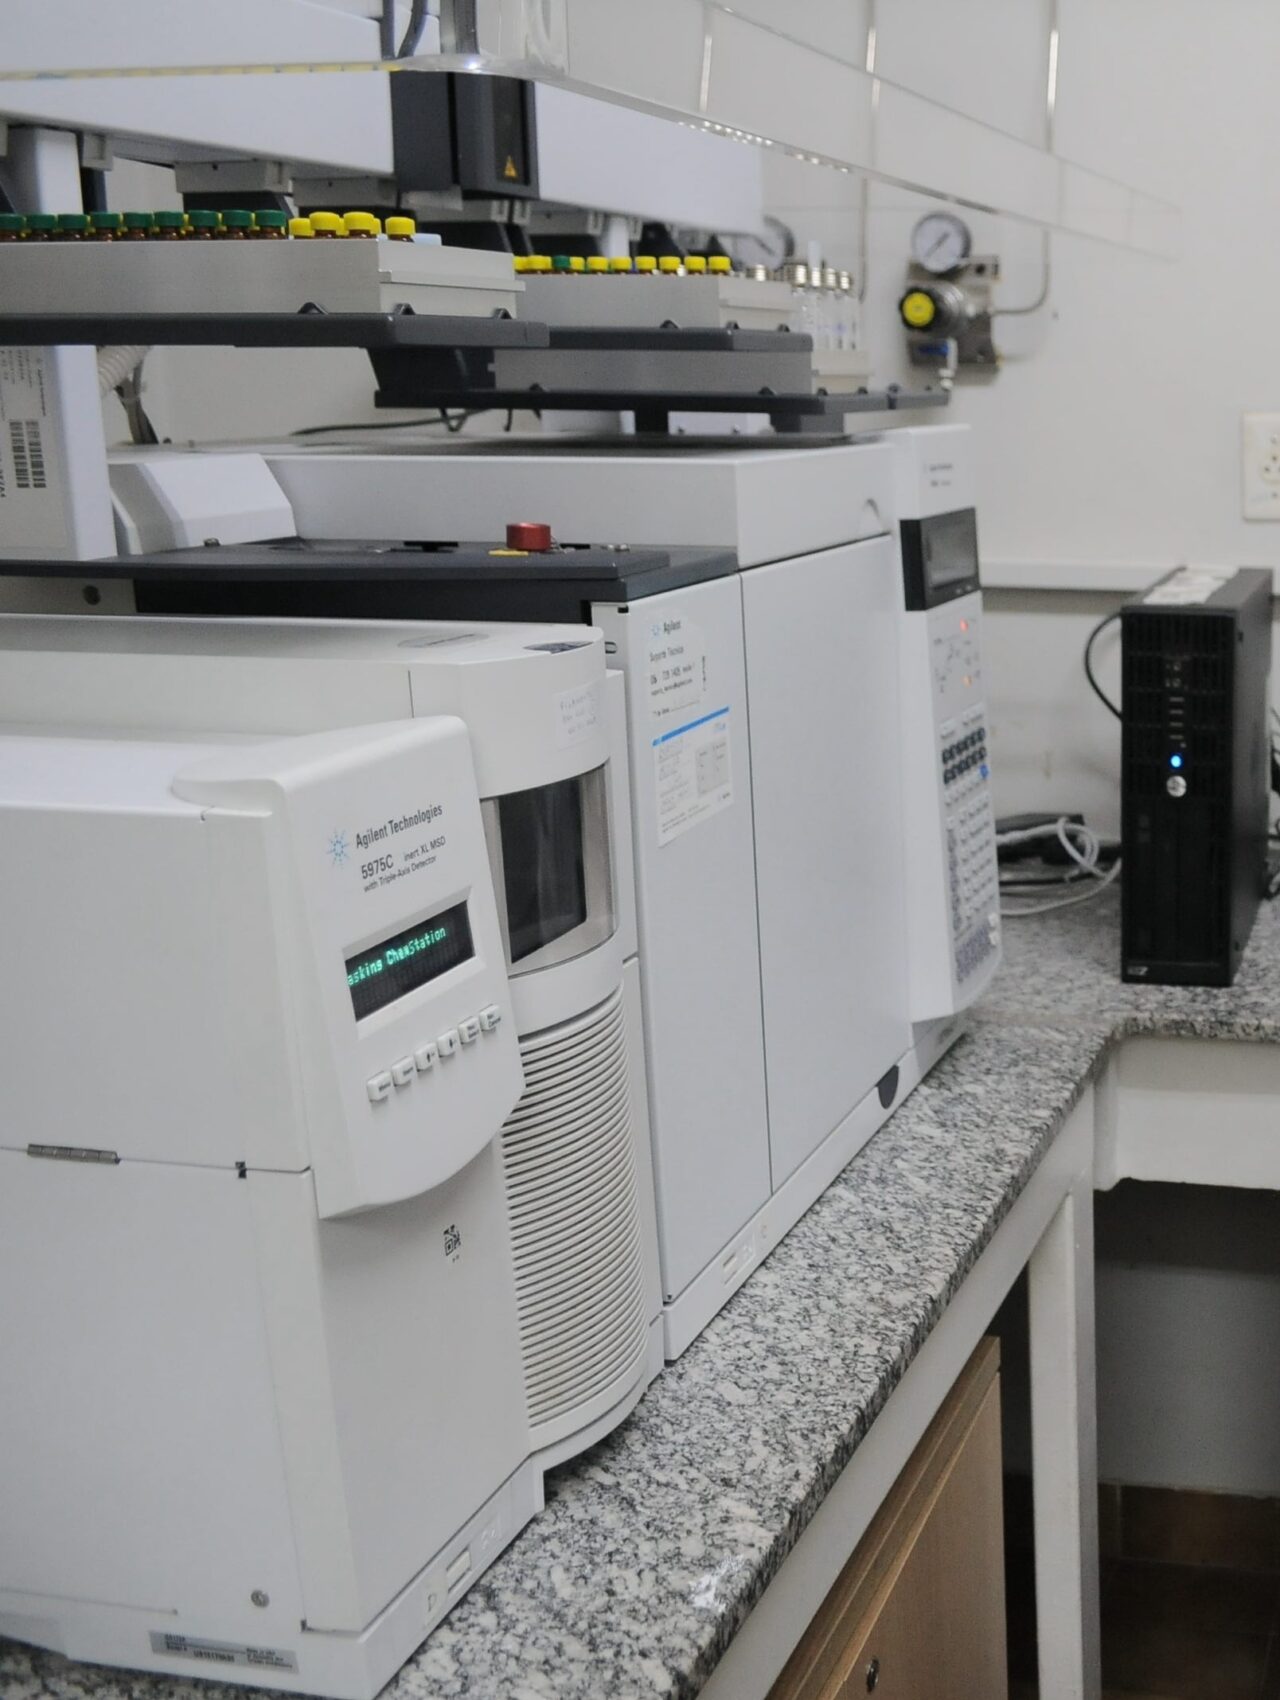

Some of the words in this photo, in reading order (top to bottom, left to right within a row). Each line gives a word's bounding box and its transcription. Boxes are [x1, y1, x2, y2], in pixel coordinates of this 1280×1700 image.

[356, 825, 388, 849] Agilent
[388, 804, 443, 835] Technologies
[361, 854, 394, 880] 5975C
[404, 848, 420, 861] inert
[420, 843, 429, 855] XL
[430, 836, 446, 850] MSD
[363, 880, 379, 892] with
[379, 866, 411, 886] Triple-Axis
[411, 855, 437, 872] Detector
[347, 959, 383, 986] asking
[385, 927, 447, 965] ChemStation
